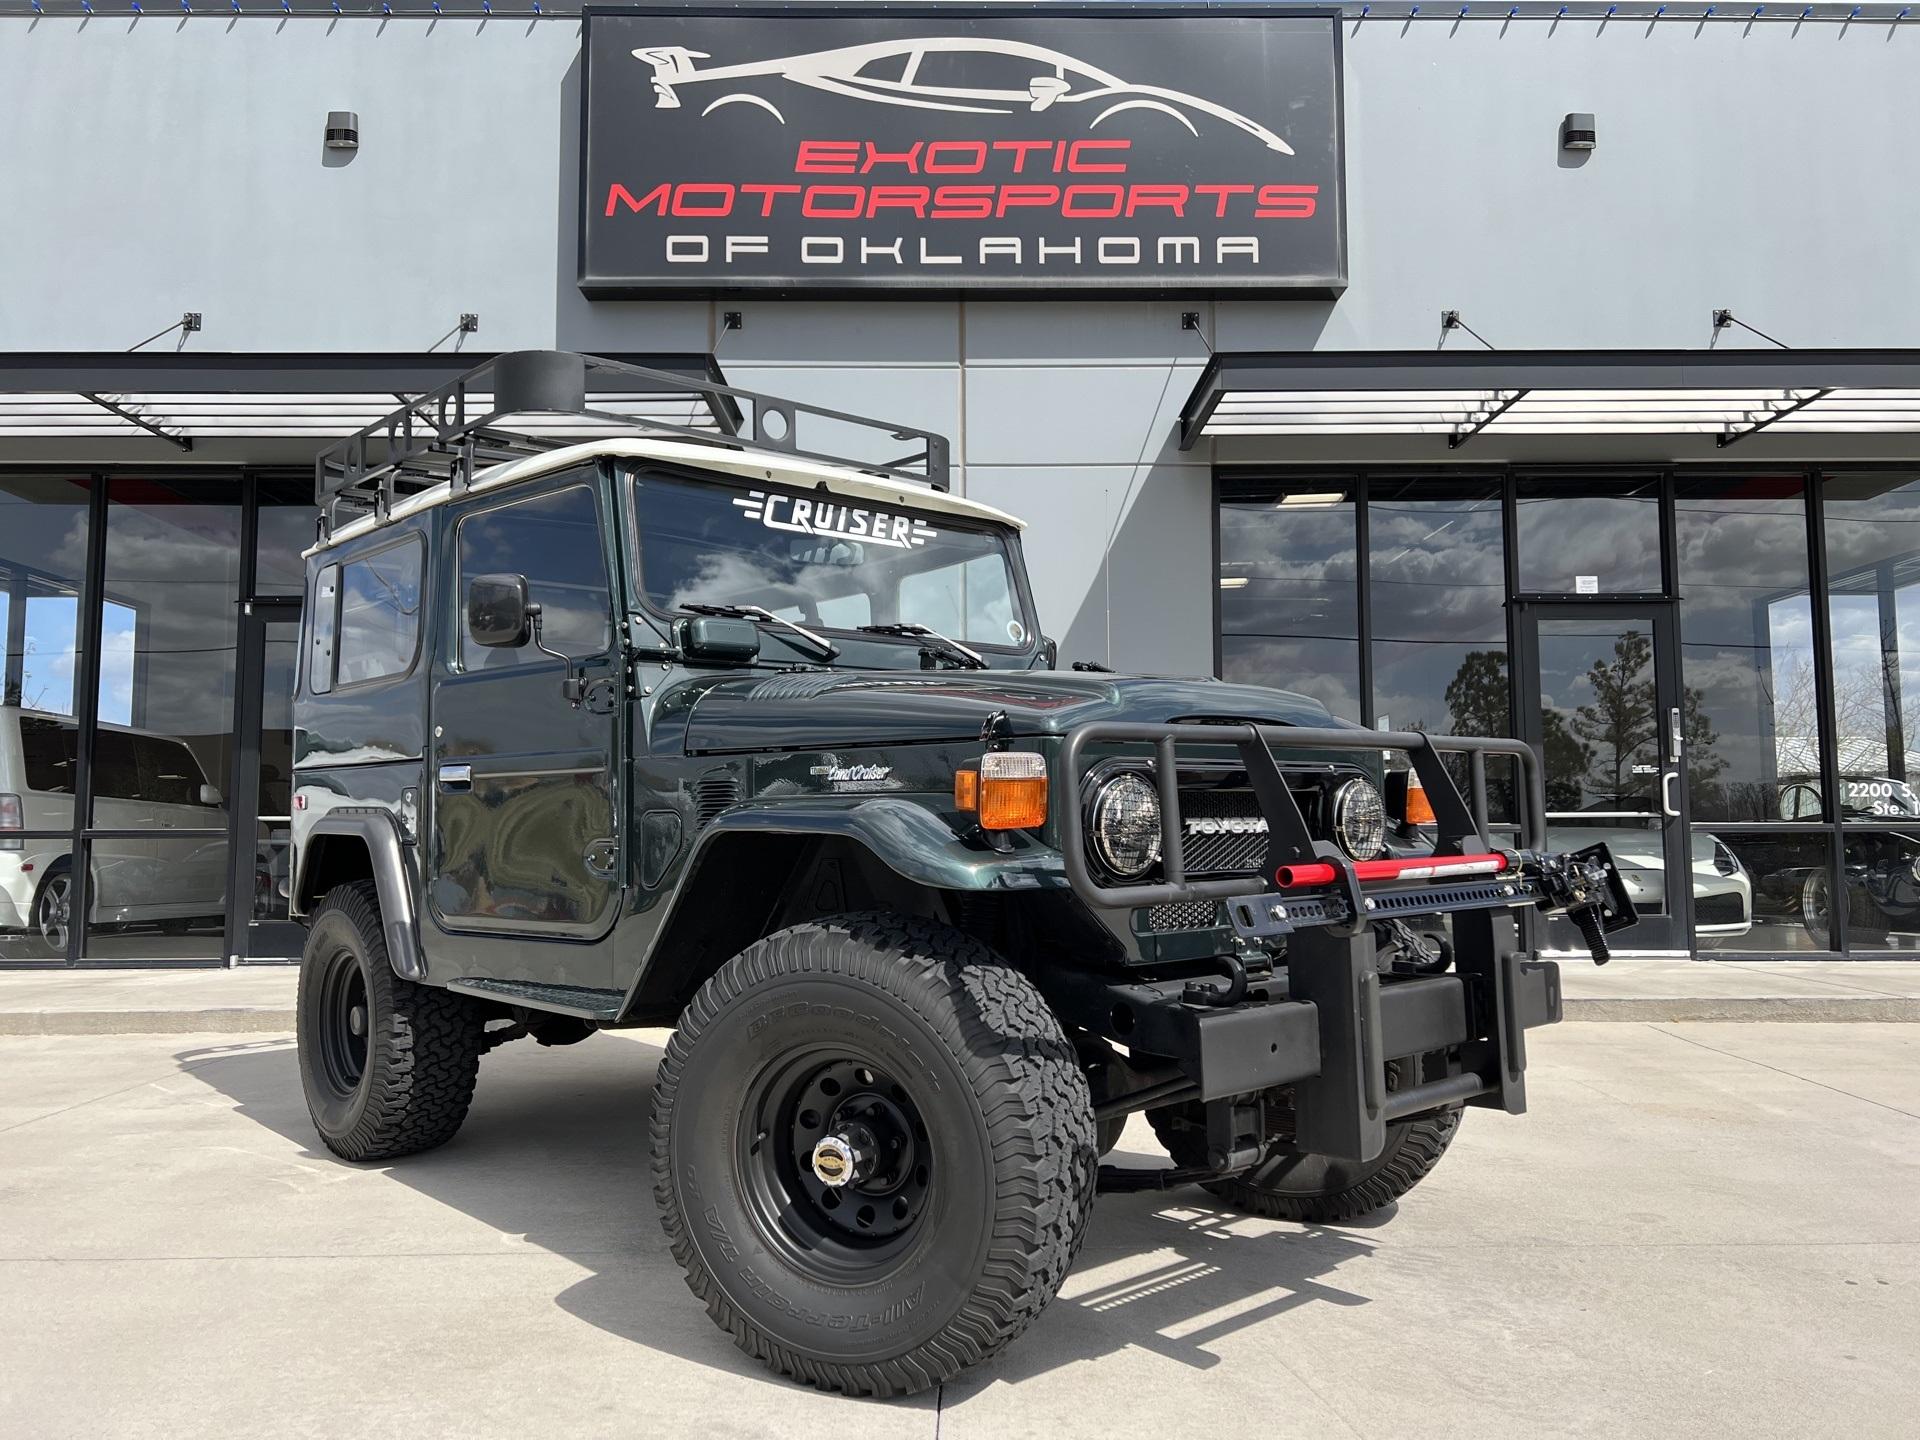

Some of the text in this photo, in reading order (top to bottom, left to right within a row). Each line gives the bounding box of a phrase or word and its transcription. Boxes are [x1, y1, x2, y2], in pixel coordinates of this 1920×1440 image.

[796, 140, 1131, 174] EXOTIC
[605, 183, 1318, 218] MOTORSPORTS
[667, 236, 1259, 264] OF OKLAHOMA
[763, 494, 912, 549] CRUISER
[828, 765, 856, 781] Land
[852, 763, 889, 780] Cruiser
[1848, 783, 1892, 797] 2200
[1873, 801, 1904, 815] Ste.
[1185, 817, 1269, 835] TOYOTA
